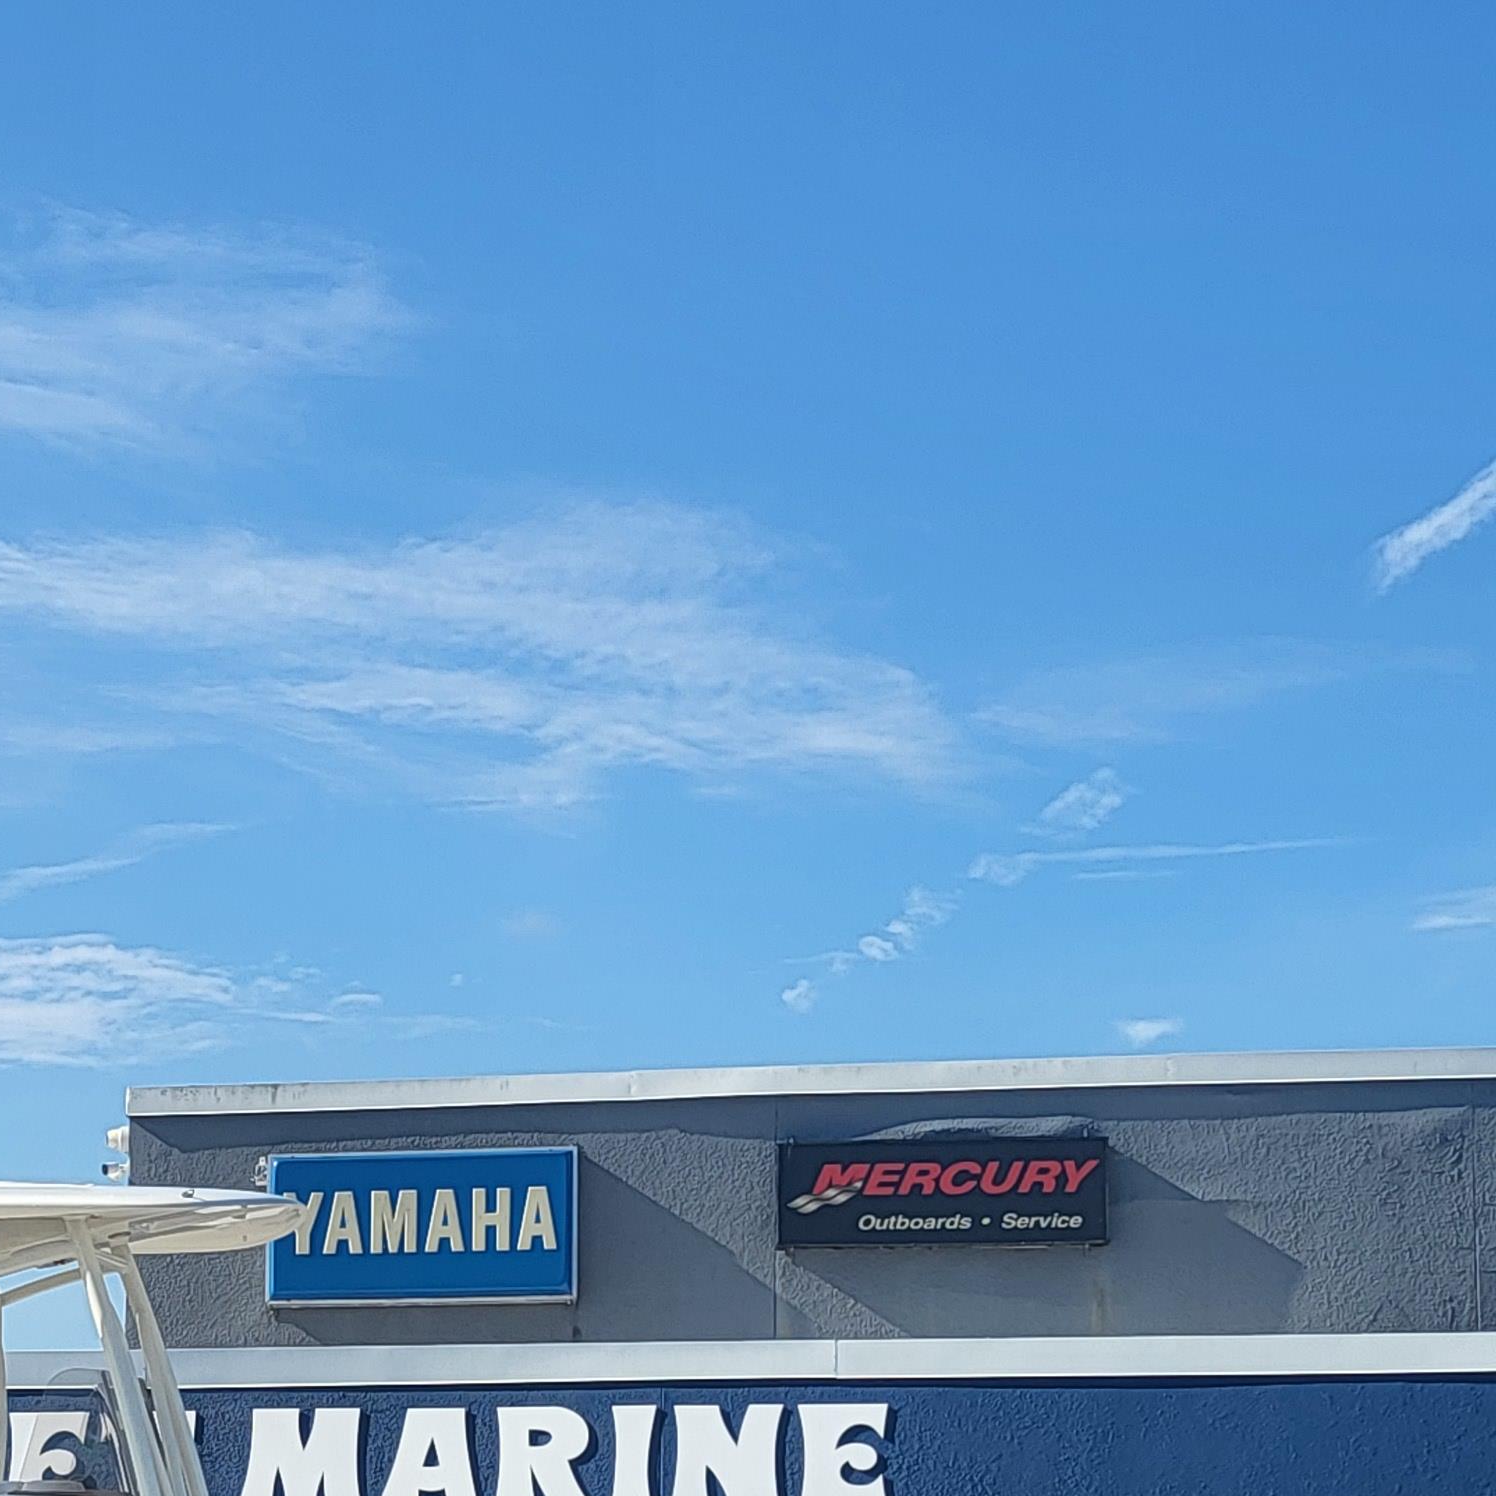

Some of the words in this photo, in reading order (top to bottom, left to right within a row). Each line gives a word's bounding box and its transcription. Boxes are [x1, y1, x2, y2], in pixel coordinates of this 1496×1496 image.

[811, 1159, 1100, 1197] MERCURY
[283, 1186, 558, 1255] YAMAHA
[857, 1213, 972, 1231] Outboards
[1000, 1212, 1083, 1229] Service
